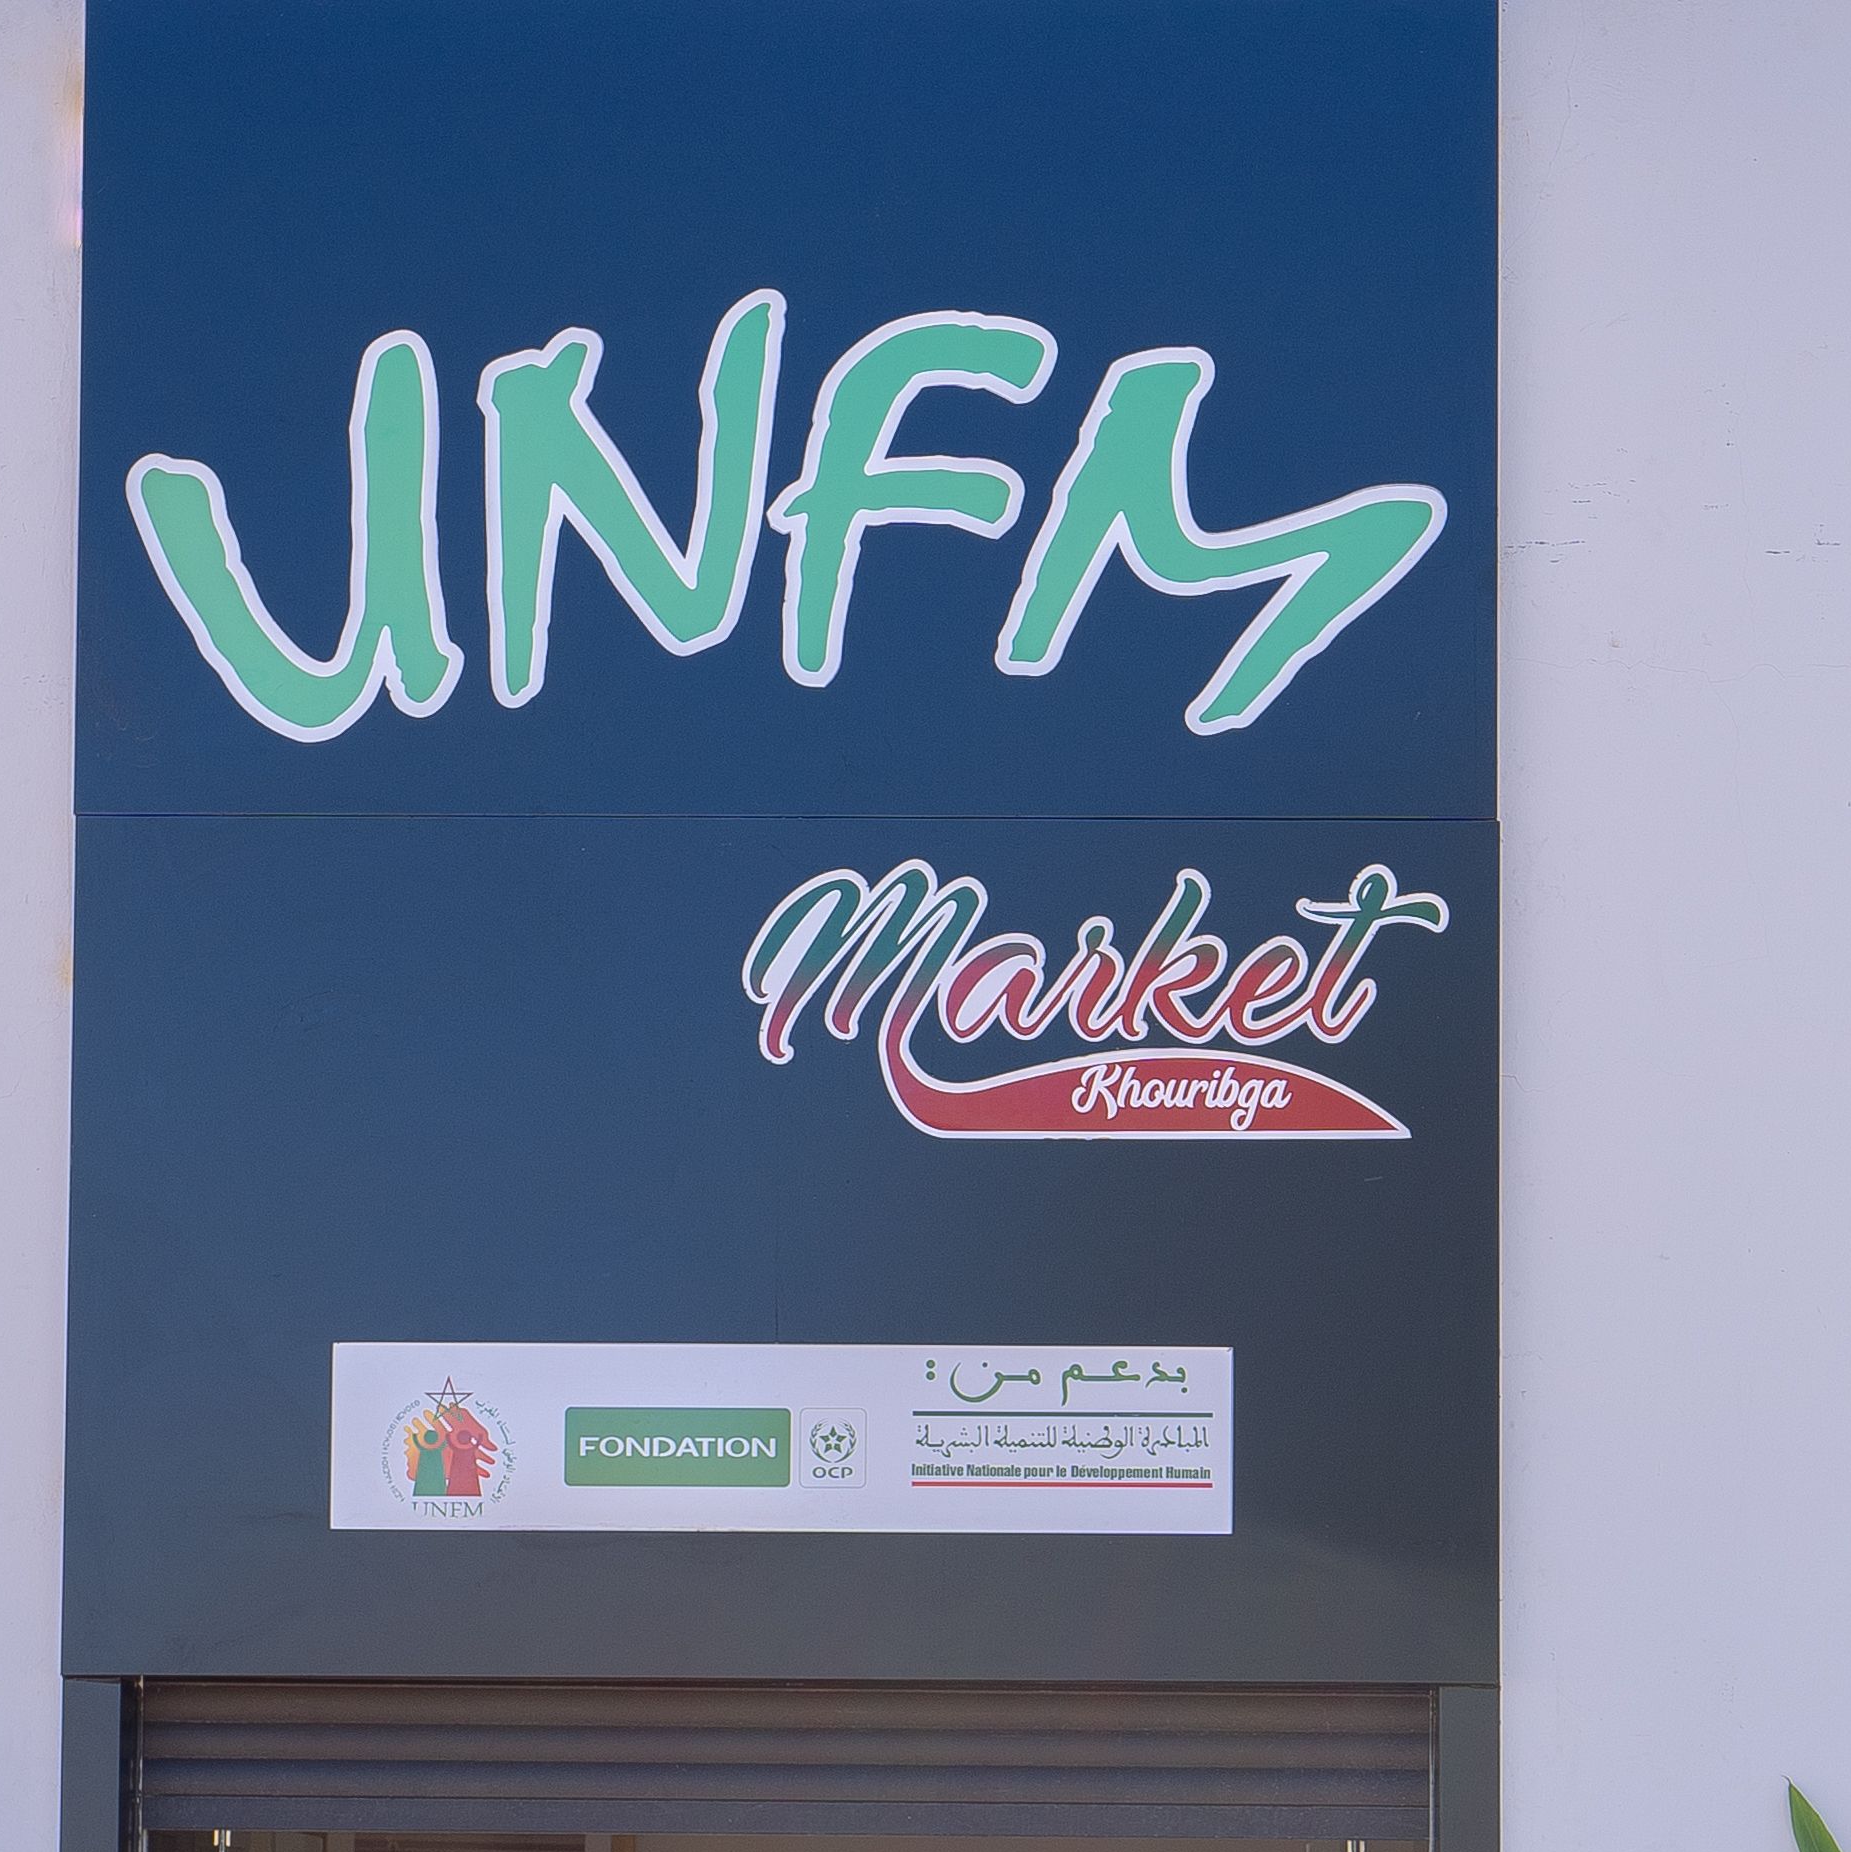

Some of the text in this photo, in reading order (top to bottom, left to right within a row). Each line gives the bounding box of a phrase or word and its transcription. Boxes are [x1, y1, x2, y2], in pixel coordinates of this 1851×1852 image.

[126, 289, 1447, 743] UNFM
[742, 858, 1450, 1066] Market
[1070, 1060, 1293, 1132] Khouribga
[949, 1359, 1042, 1403] من
[1060, 1358, 1189, 1407] بدعم
[577, 1434, 778, 1460] FONDATION
[915, 1423, 990, 1458] البشرية
[993, 1424, 1058, 1454] للتنمية
[1061, 1424, 1135, 1460] الوطنية
[812, 1466, 854, 1480] OCP
[911, 1463, 1211, 1481] Initiative Nationale pour le Développement Humain
[412, 1500, 485, 1518] UNFM
